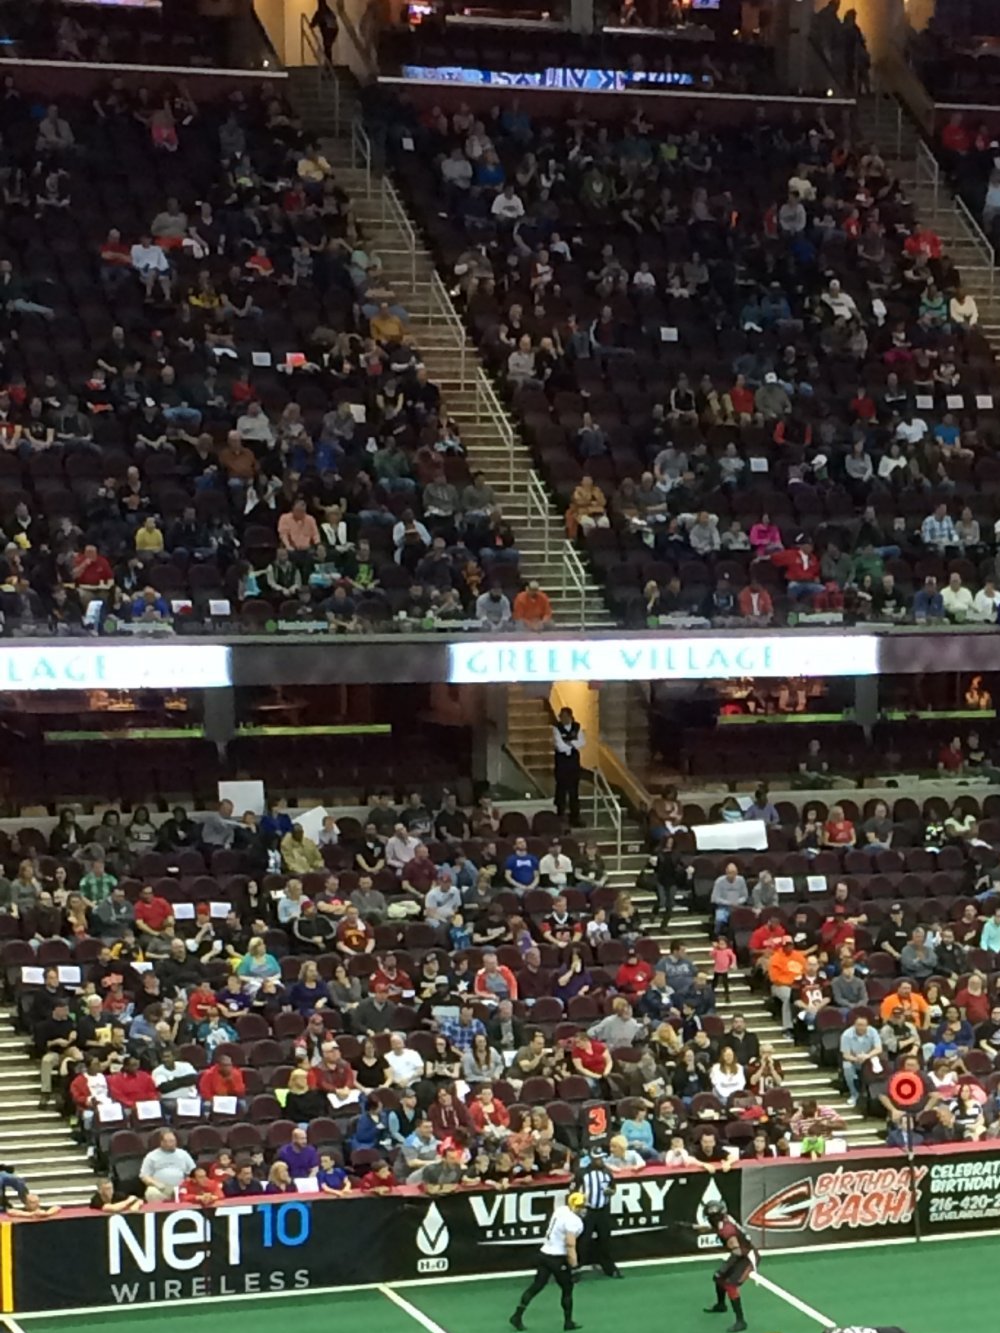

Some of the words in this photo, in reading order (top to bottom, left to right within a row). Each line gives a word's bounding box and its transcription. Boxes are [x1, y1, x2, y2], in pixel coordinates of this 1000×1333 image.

[465, 647, 593, 674] GREEK
[619, 644, 774, 672] VILLAGE
[588, 1106, 607, 1136] 3
[814, 1165, 928, 1196] BIRTHDAY
[469, 1178, 674, 1227] VICTRY
[810, 1190, 922, 1231] BASH!
[485, 1225, 541, 1239] ELITE
[111, 1269, 311, 1304] WIRELESS
